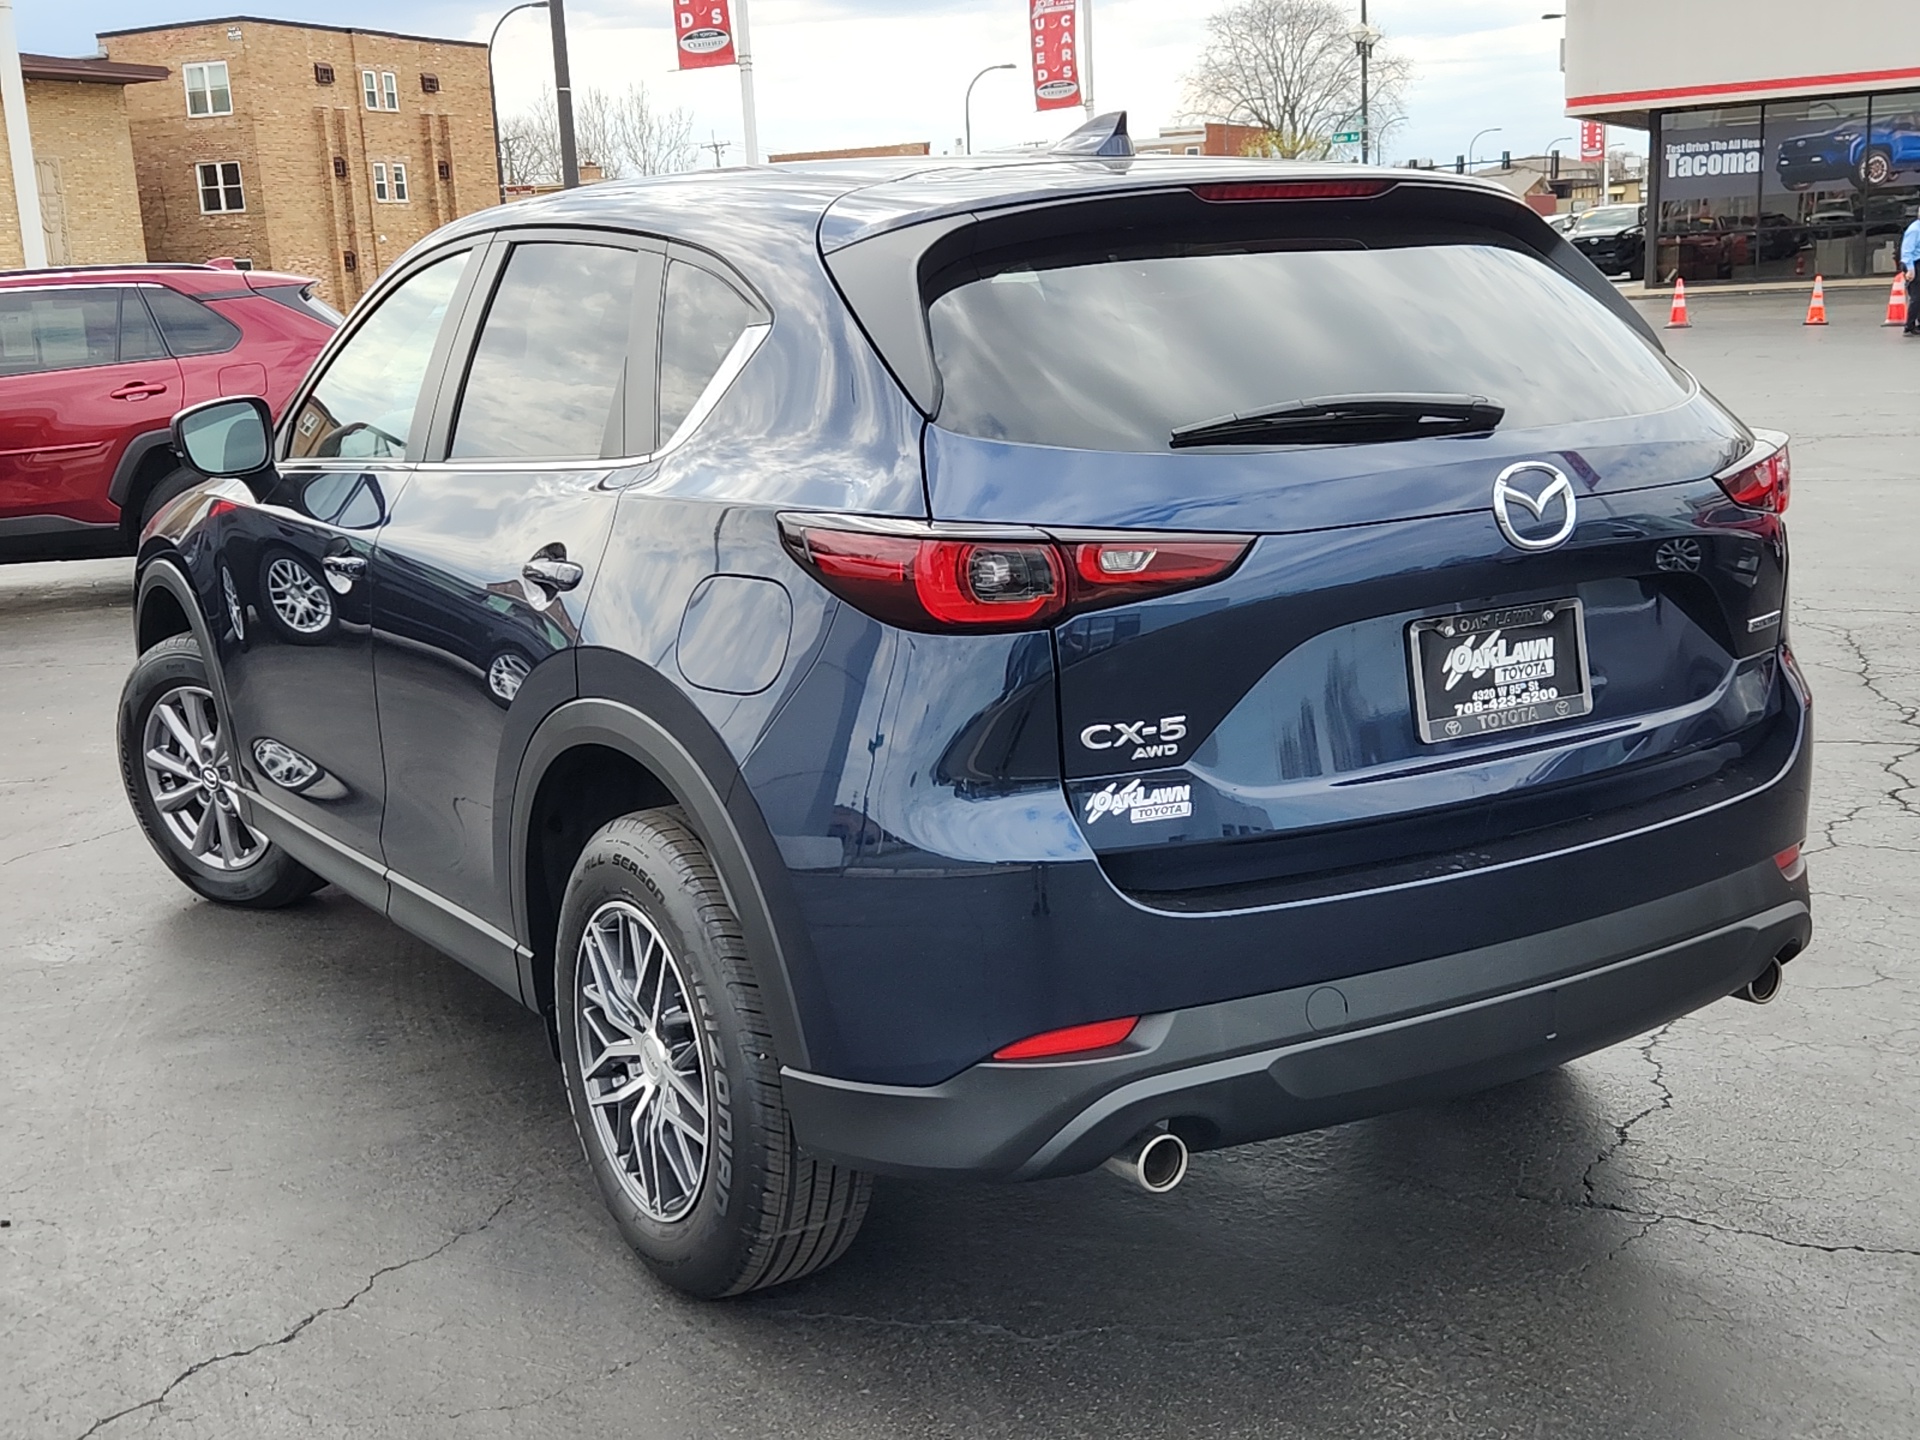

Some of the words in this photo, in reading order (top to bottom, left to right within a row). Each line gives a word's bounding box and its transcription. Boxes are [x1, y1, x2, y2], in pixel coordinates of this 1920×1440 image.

[1035, 18, 1048, 81] USED
[1060, 15, 1072, 78] CARS
[1666, 144, 1685, 154] Test
[1686, 142, 1710, 153] Drive
[1711, 140, 1727, 151] The
[1728, 139, 1740, 150] All
[1665, 151, 1764, 178] Tacoma
[1501, 661, 1547, 680] TOYOTA
[1454, 687, 1558, 716] 708-423-5200
[1472, 689, 1496, 701] 4320
[1498, 687, 1508, 697] W
[1528, 680, 1539, 691] St
[1477, 707, 1539, 729] TOYOTA
[1080, 715, 1187, 750] CX-5
[1131, 743, 1178, 760] AWD
[1138, 804, 1183, 818] TOYOTA
[611, 853, 665, 905] SEASON
